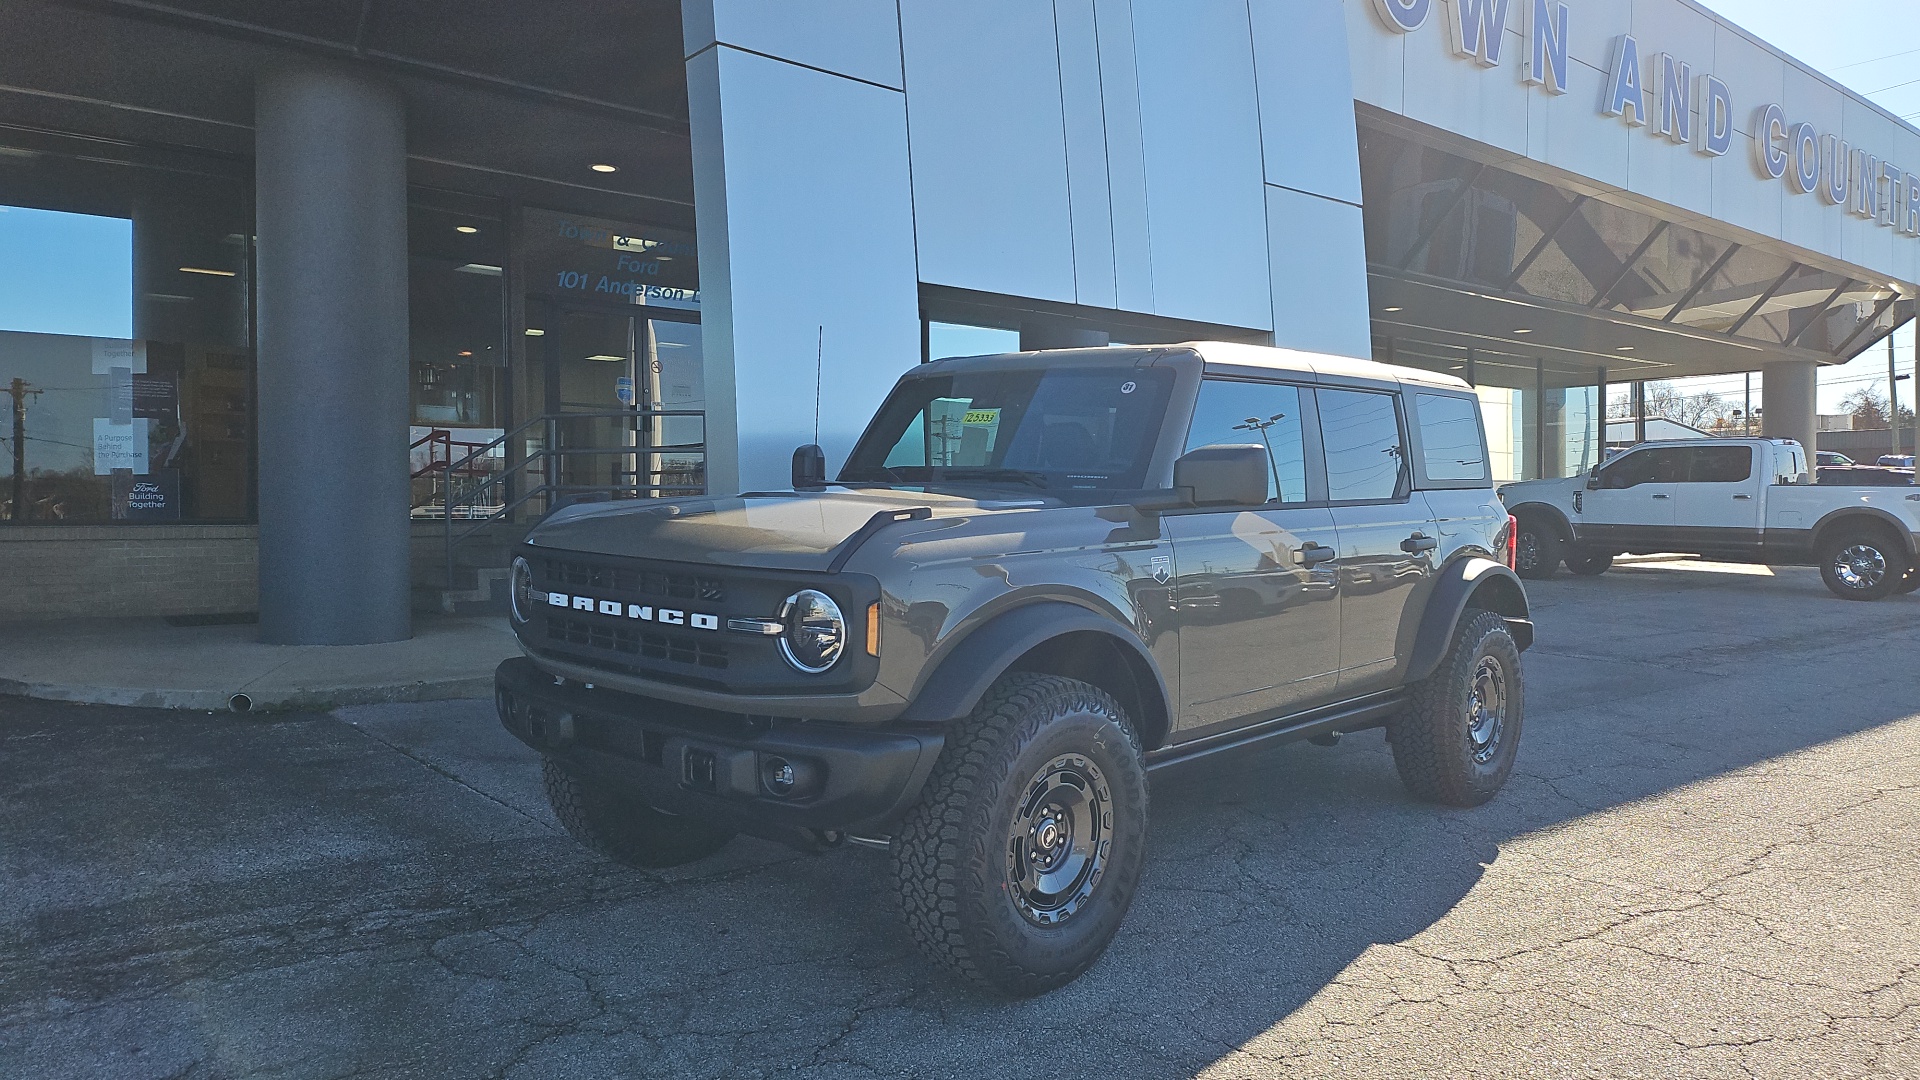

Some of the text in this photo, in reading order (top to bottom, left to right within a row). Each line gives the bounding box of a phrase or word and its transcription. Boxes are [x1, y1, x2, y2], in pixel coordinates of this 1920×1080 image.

[1602, 33, 1734, 158] AND
[1754, 102, 1920, 238] COUNTR
[616, 236, 631, 247] &
[617, 255, 660, 276] Ford
[557, 270, 589, 290] 101
[595, 275, 685, 302] Anderson
[98, 434, 133, 443] A Purpose
[98, 451, 143, 459] the Purchase
[132, 482, 160, 493] Ford
[128, 492, 164, 502] Building
[127, 501, 166, 510] Together
[548, 592, 719, 631] BRONCO
